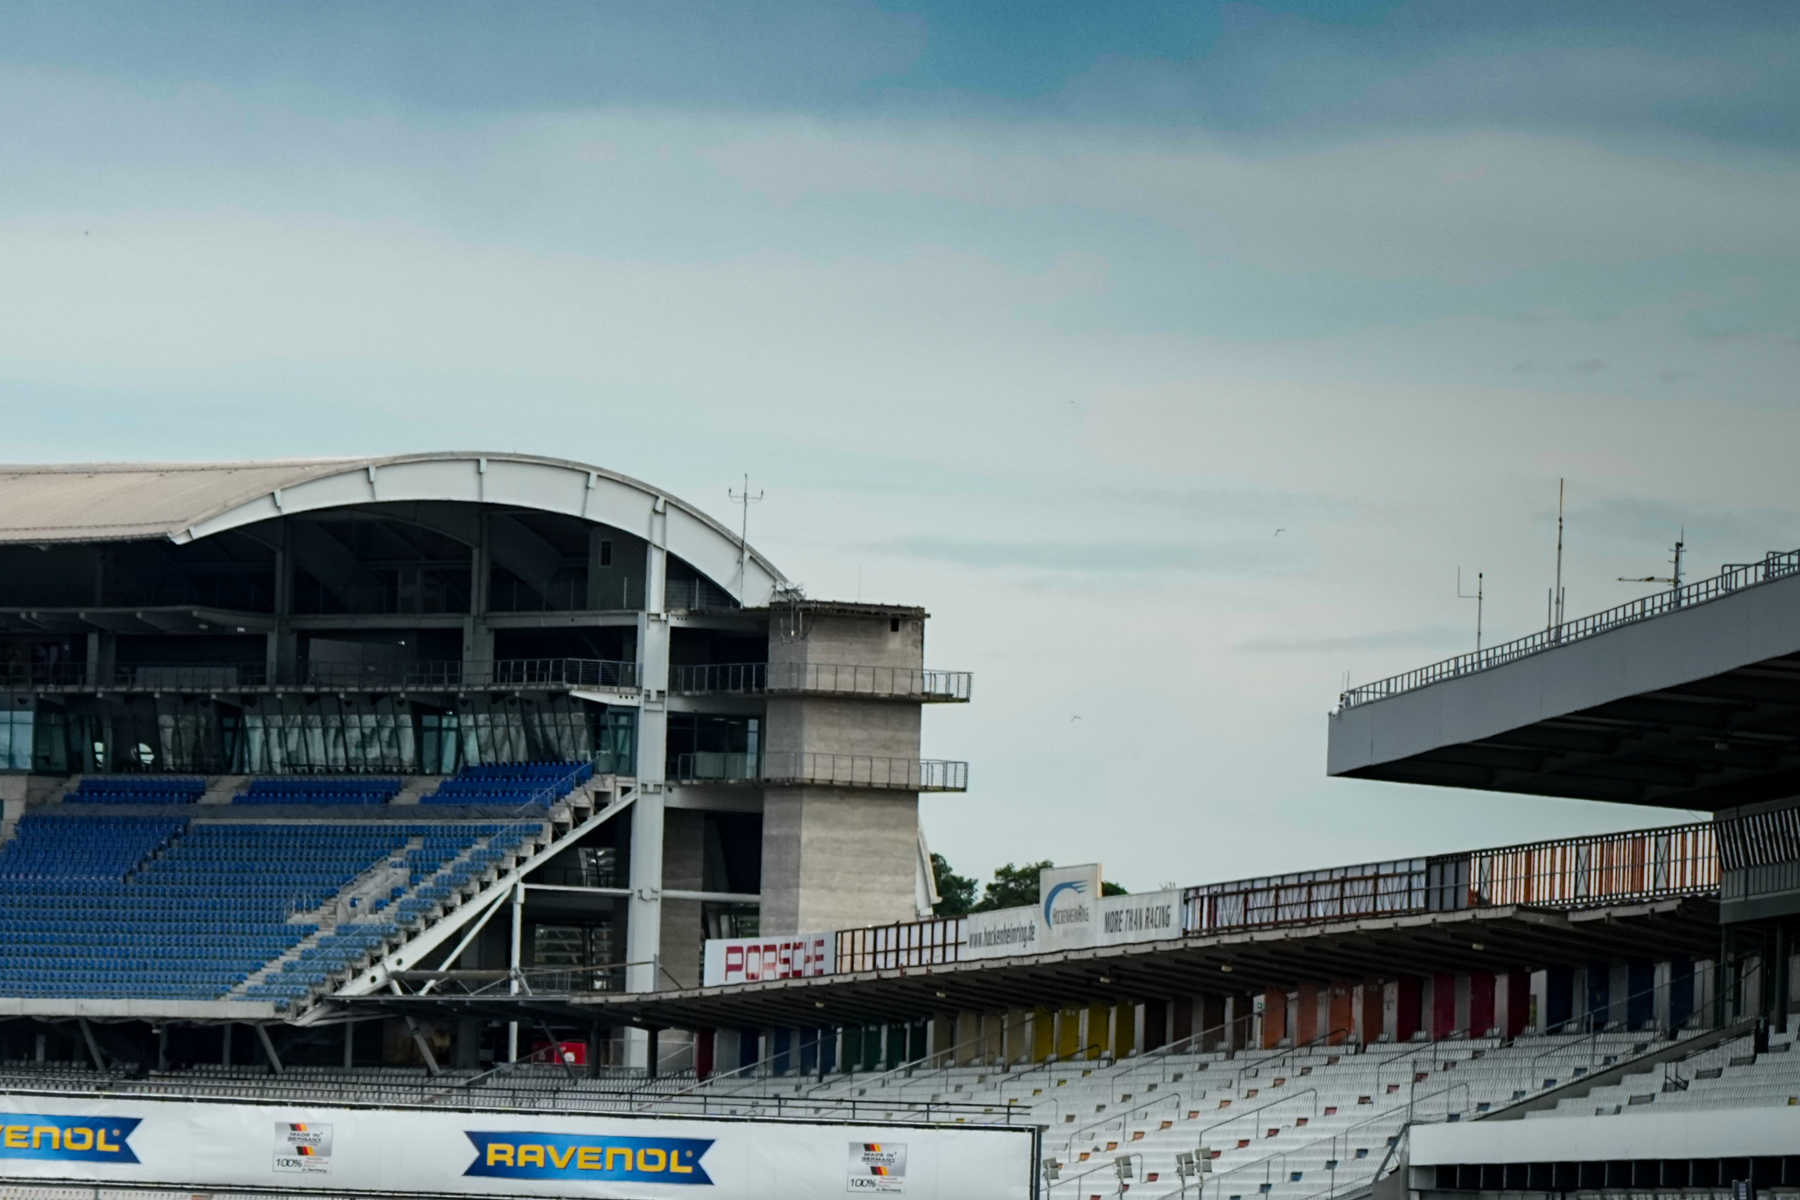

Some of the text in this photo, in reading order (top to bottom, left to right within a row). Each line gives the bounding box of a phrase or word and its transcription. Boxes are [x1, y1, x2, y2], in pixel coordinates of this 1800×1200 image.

[1104, 909, 1123, 933] MORE
[1145, 904, 1171, 930] RACING
[725, 939, 825, 982] PORSCHE
[485, 1143, 693, 1174] RAVENOL
